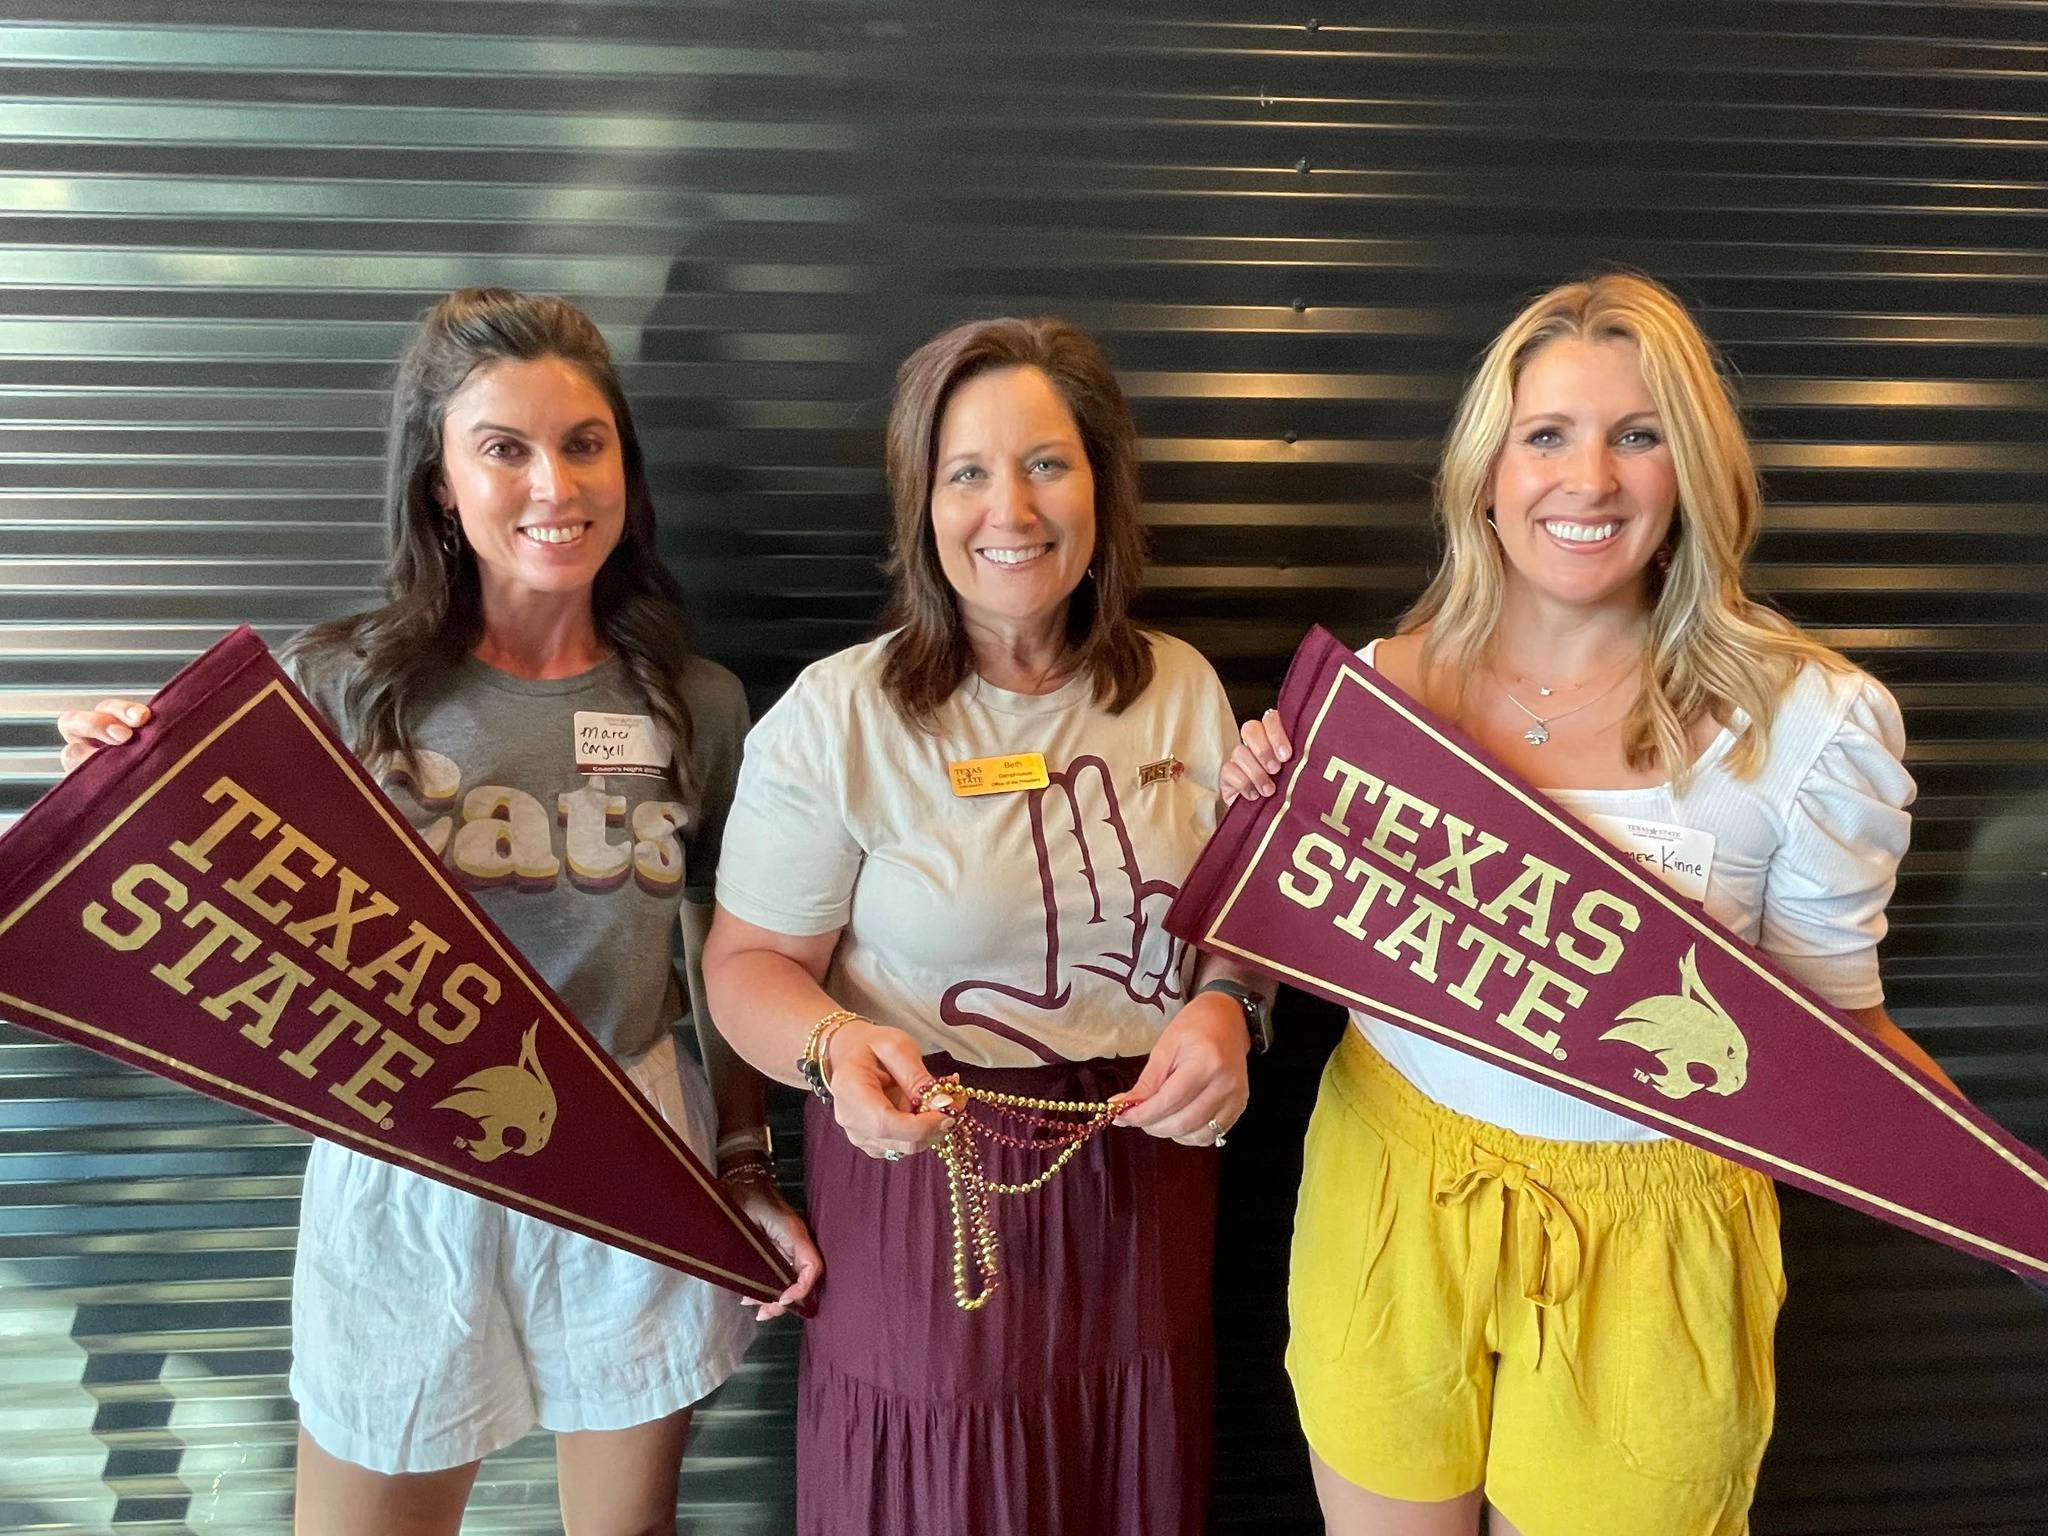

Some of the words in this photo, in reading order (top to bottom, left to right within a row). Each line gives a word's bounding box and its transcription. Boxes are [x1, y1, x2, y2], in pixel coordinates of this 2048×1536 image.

[580, 724, 633, 739] Marci
[582, 741, 624, 760] Coryell
[954, 766, 983, 776] TEXAS
[1004, 761, 1023, 769] Beth
[957, 776, 984, 785] STATE
[1318, 755, 1641, 975] TEXAS
[1661, 845, 1703, 877] Kinne
[168, 775, 502, 1045] TEXAS
[1277, 831, 1590, 1058] STATE
[81, 862, 435, 1125] STATE
